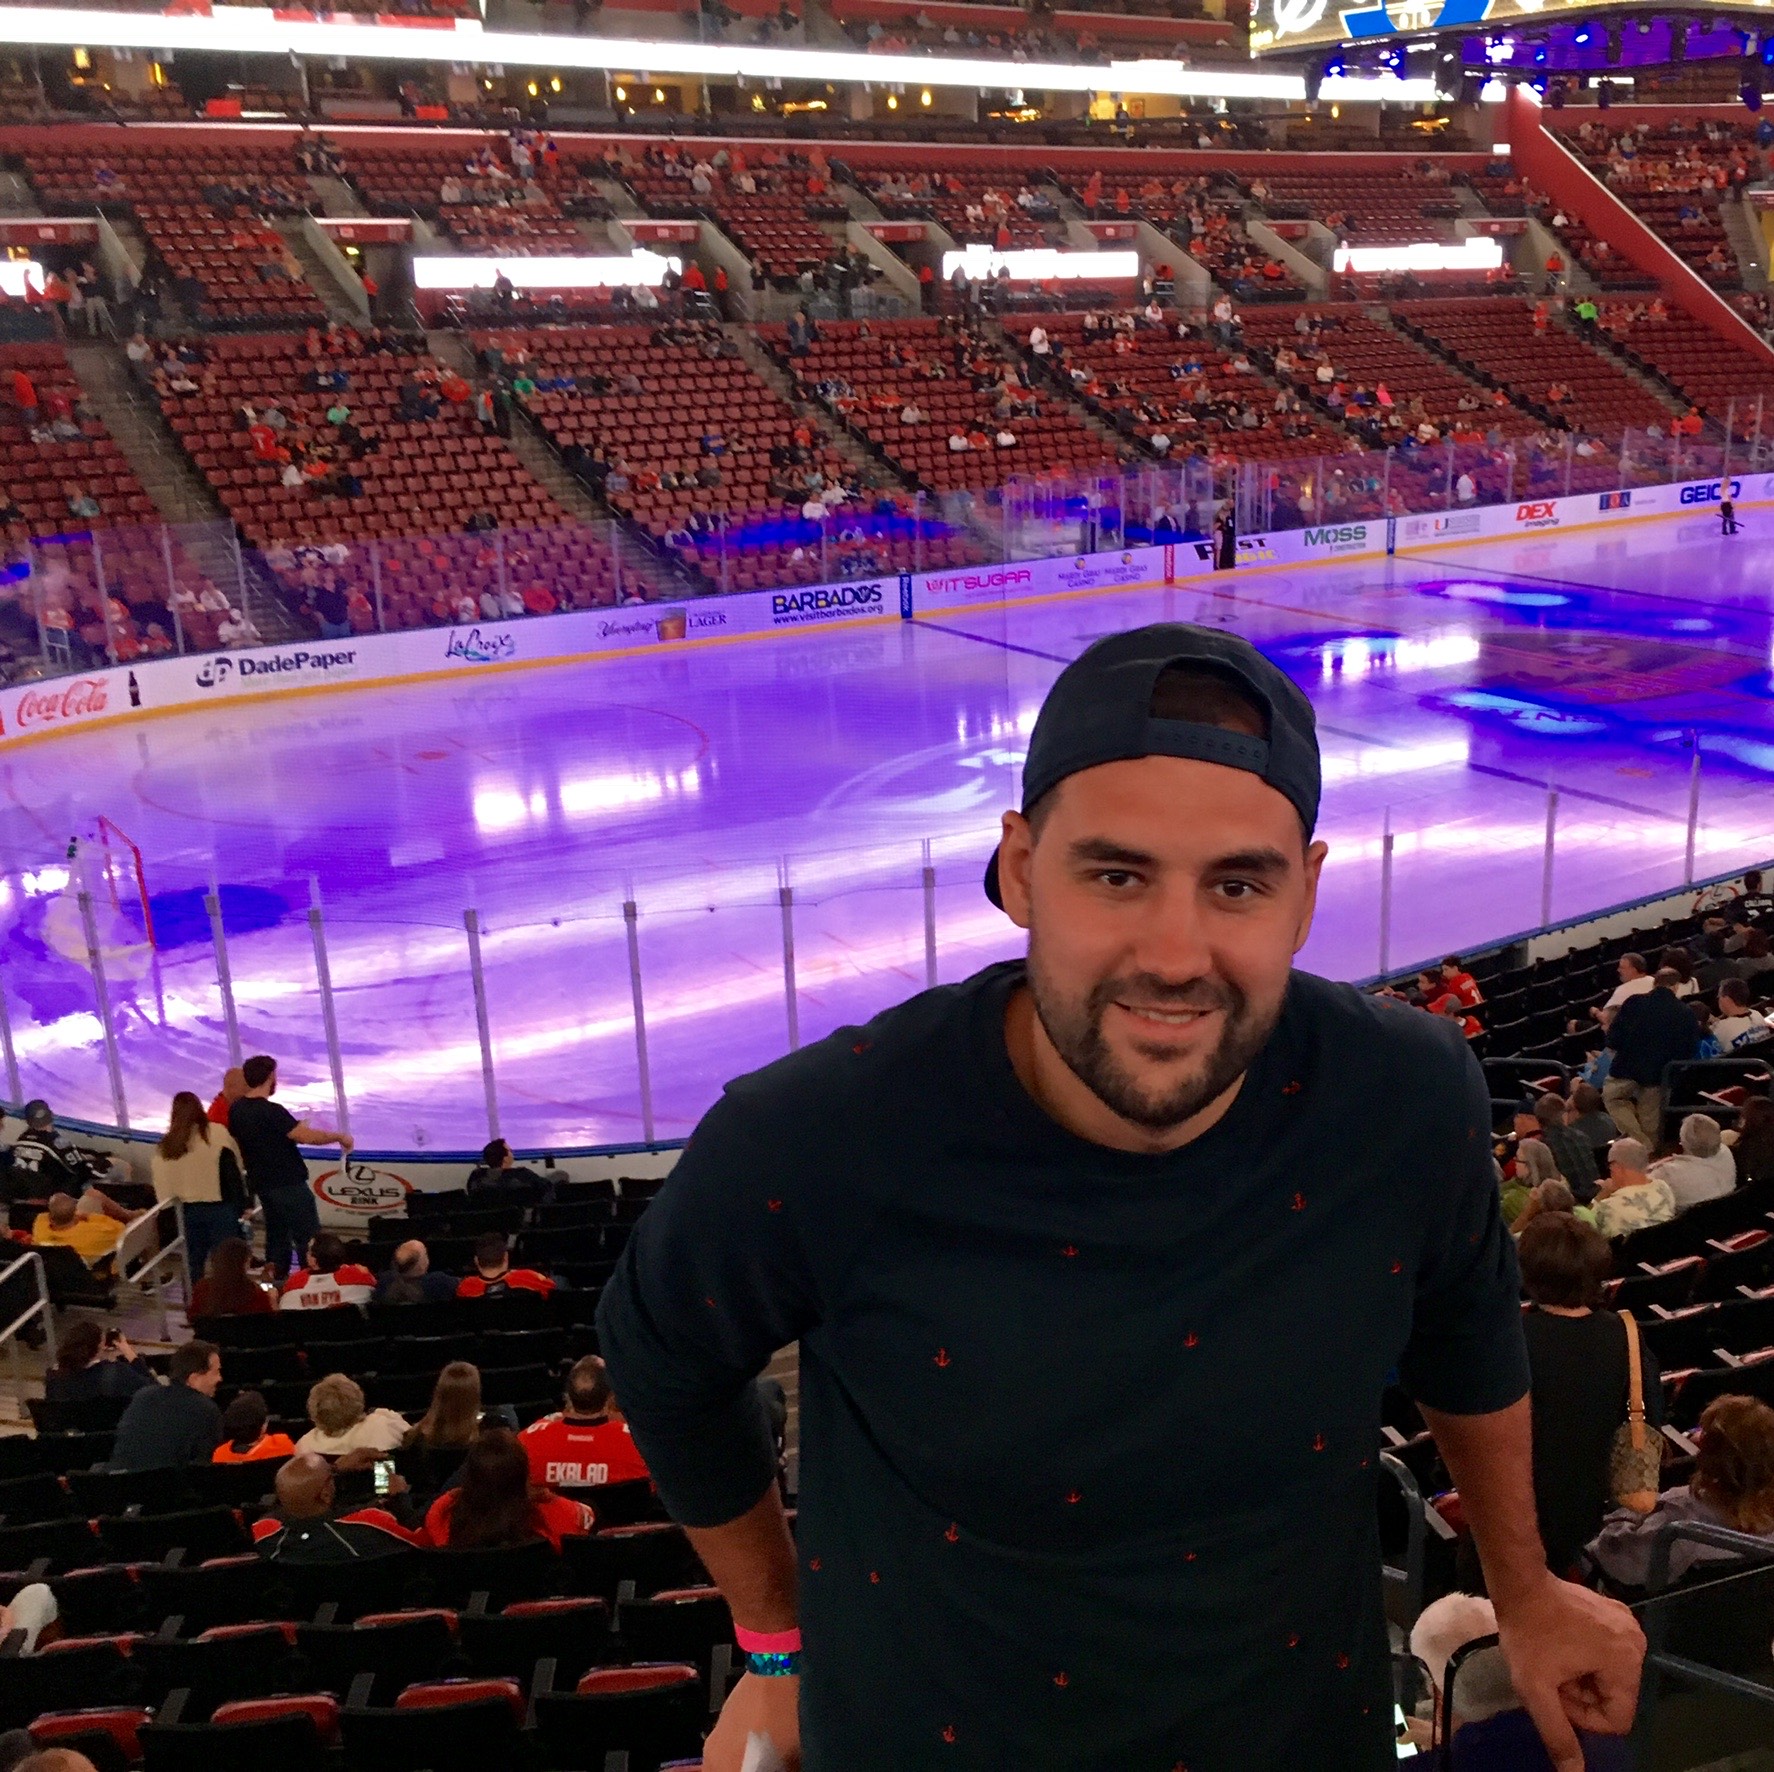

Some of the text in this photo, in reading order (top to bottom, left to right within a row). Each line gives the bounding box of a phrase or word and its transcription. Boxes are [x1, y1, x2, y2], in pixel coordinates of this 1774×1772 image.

[1516, 502, 1556, 521] DEX
[772, 584, 883, 614] BARBADOS
[689, 614, 727, 628] LAGER
[773, 605, 884, 625] www.visitbarbados.org
[238, 651, 357, 676] DadePaper
[327, 1186, 400, 1198] LEXUS
